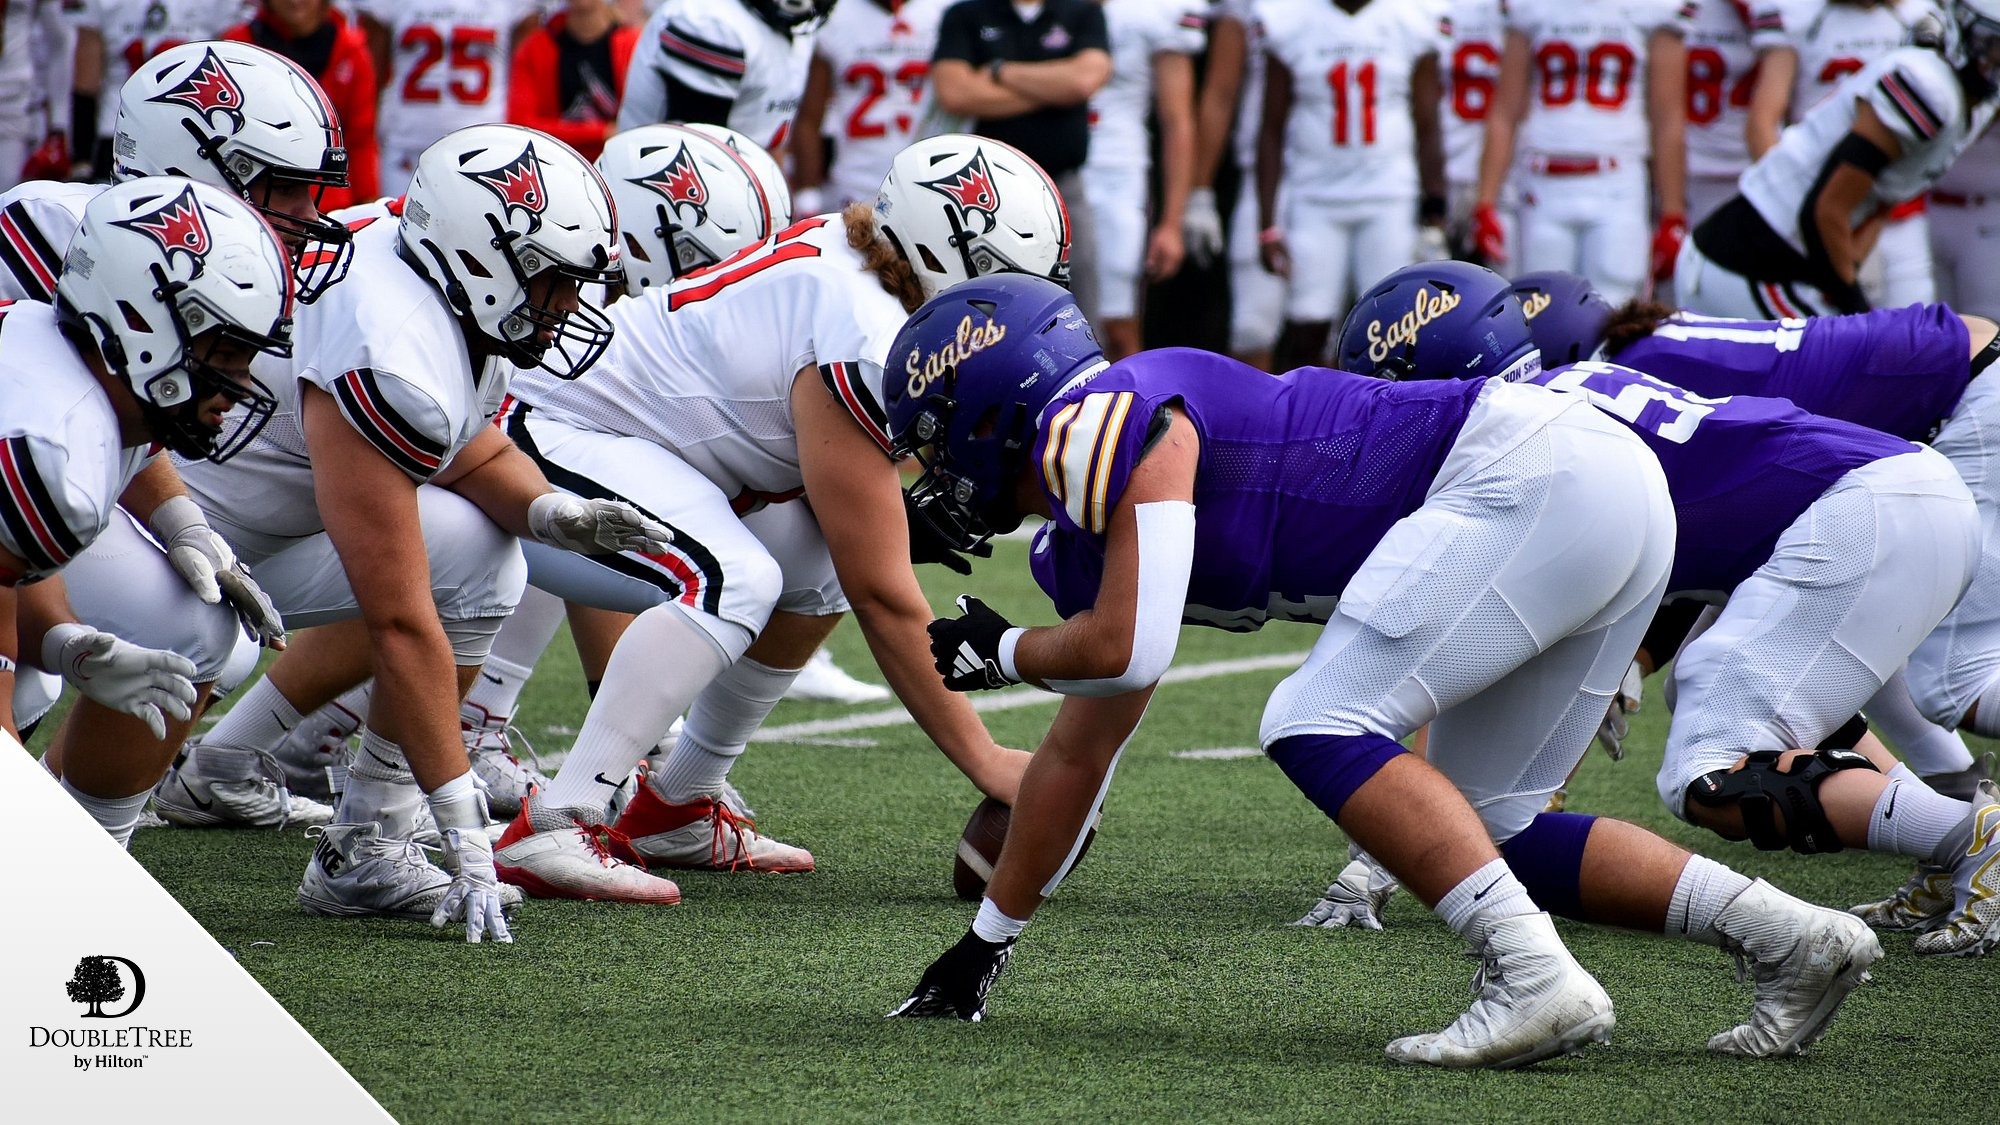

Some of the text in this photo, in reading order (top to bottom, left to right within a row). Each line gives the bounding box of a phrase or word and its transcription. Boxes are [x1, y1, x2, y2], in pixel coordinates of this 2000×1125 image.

[400, 23, 496, 105] 25
[1327, 59, 1377, 146] 11
[1537, 41, 1635, 110] 80
[905, 315, 1006, 399] Eagles
[1367, 288, 1461, 362] Eagles
[315, 830, 345, 879] NIKE
